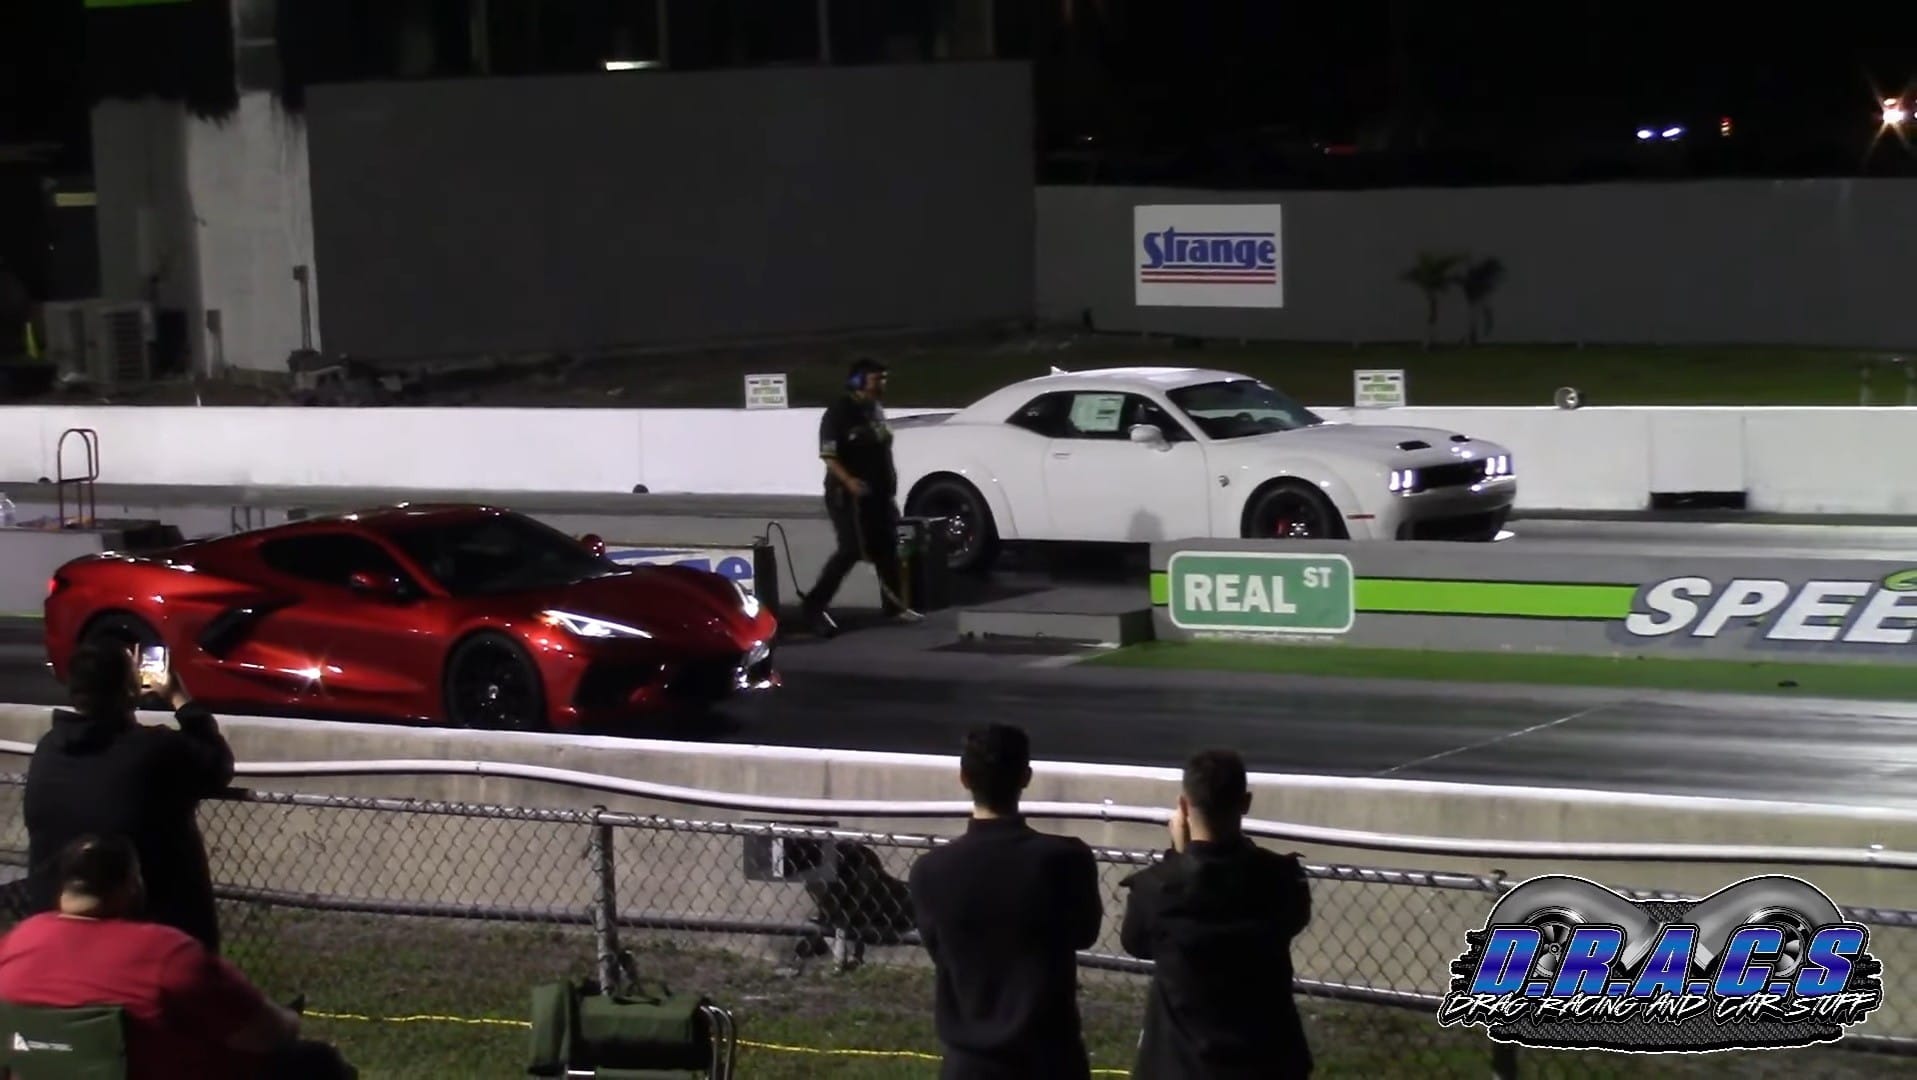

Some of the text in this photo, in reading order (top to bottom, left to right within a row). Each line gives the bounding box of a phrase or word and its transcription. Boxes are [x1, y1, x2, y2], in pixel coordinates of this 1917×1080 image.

[1143, 226, 1276, 269] Strange
[1184, 567, 1332, 613] REAL ST
